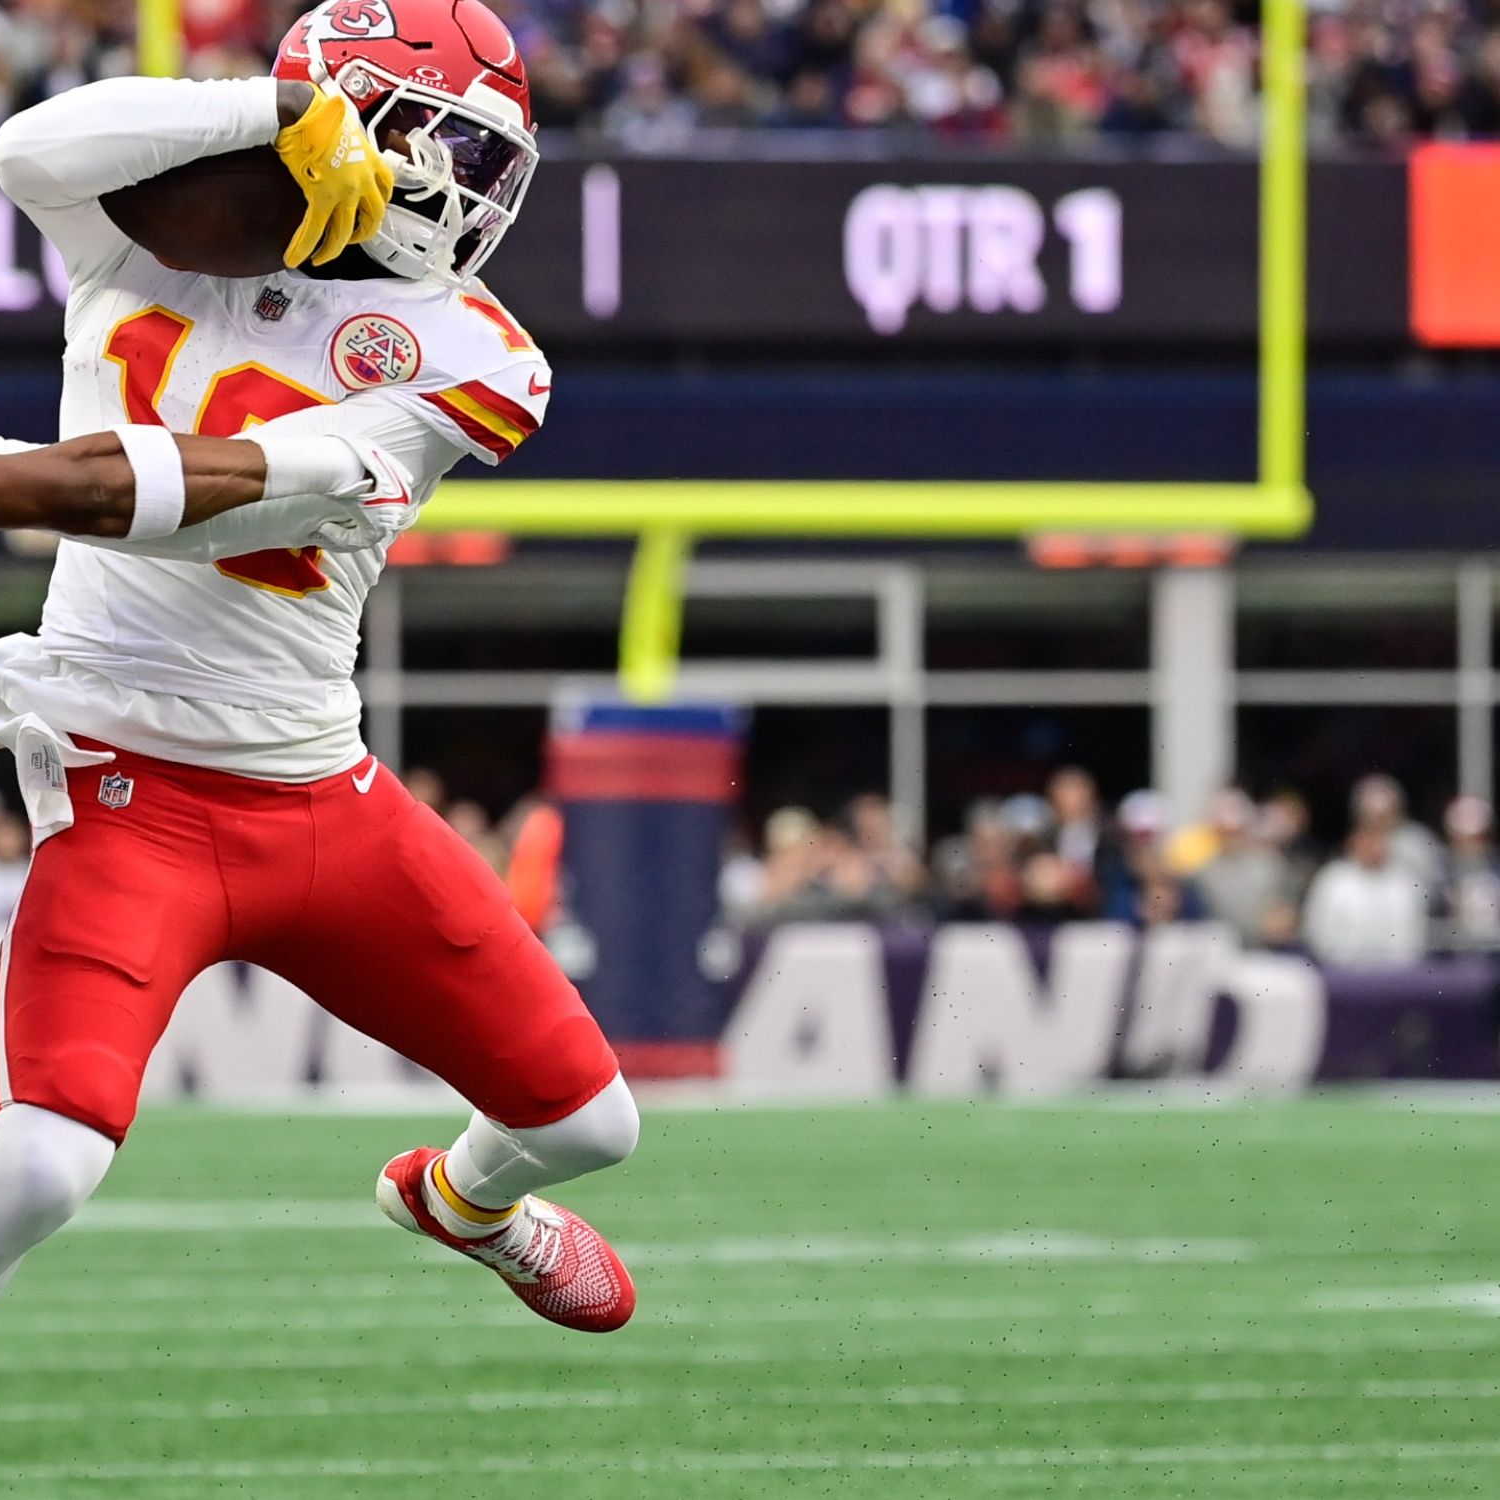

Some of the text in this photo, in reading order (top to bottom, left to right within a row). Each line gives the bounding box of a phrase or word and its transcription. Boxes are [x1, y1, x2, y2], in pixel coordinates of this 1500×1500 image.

[844, 184, 1122, 332] QTR 1
[258, 299, 283, 318] NFL
[103, 788, 125, 803] NFL
